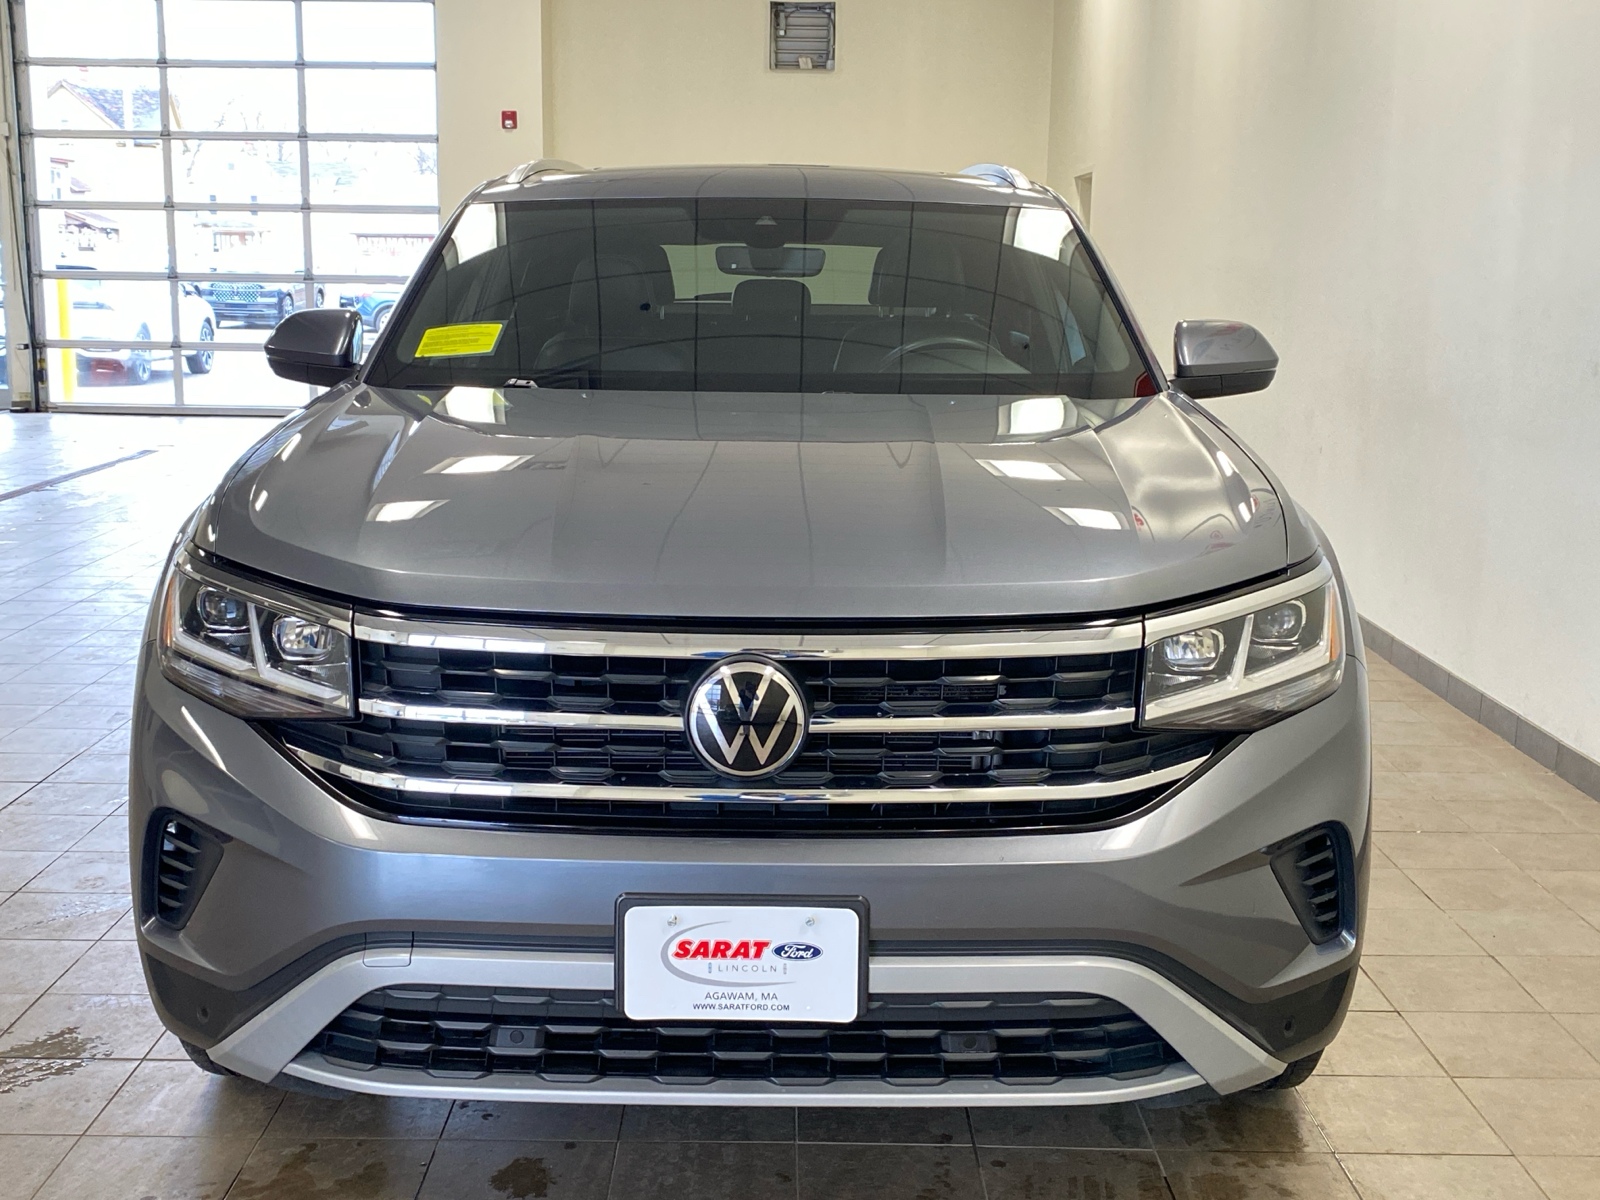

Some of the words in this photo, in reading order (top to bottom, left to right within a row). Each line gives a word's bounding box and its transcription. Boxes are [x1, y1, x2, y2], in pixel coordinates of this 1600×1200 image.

[673, 940, 771, 959] SARAT
[779, 943, 816, 959] Ford
[718, 964, 777, 973] LINCOLN
[704, 991, 758, 1001] AGAWAM,
[760, 991, 779, 1001] MA
[692, 1002, 790, 1011] WWW.SARATFORD.COM
